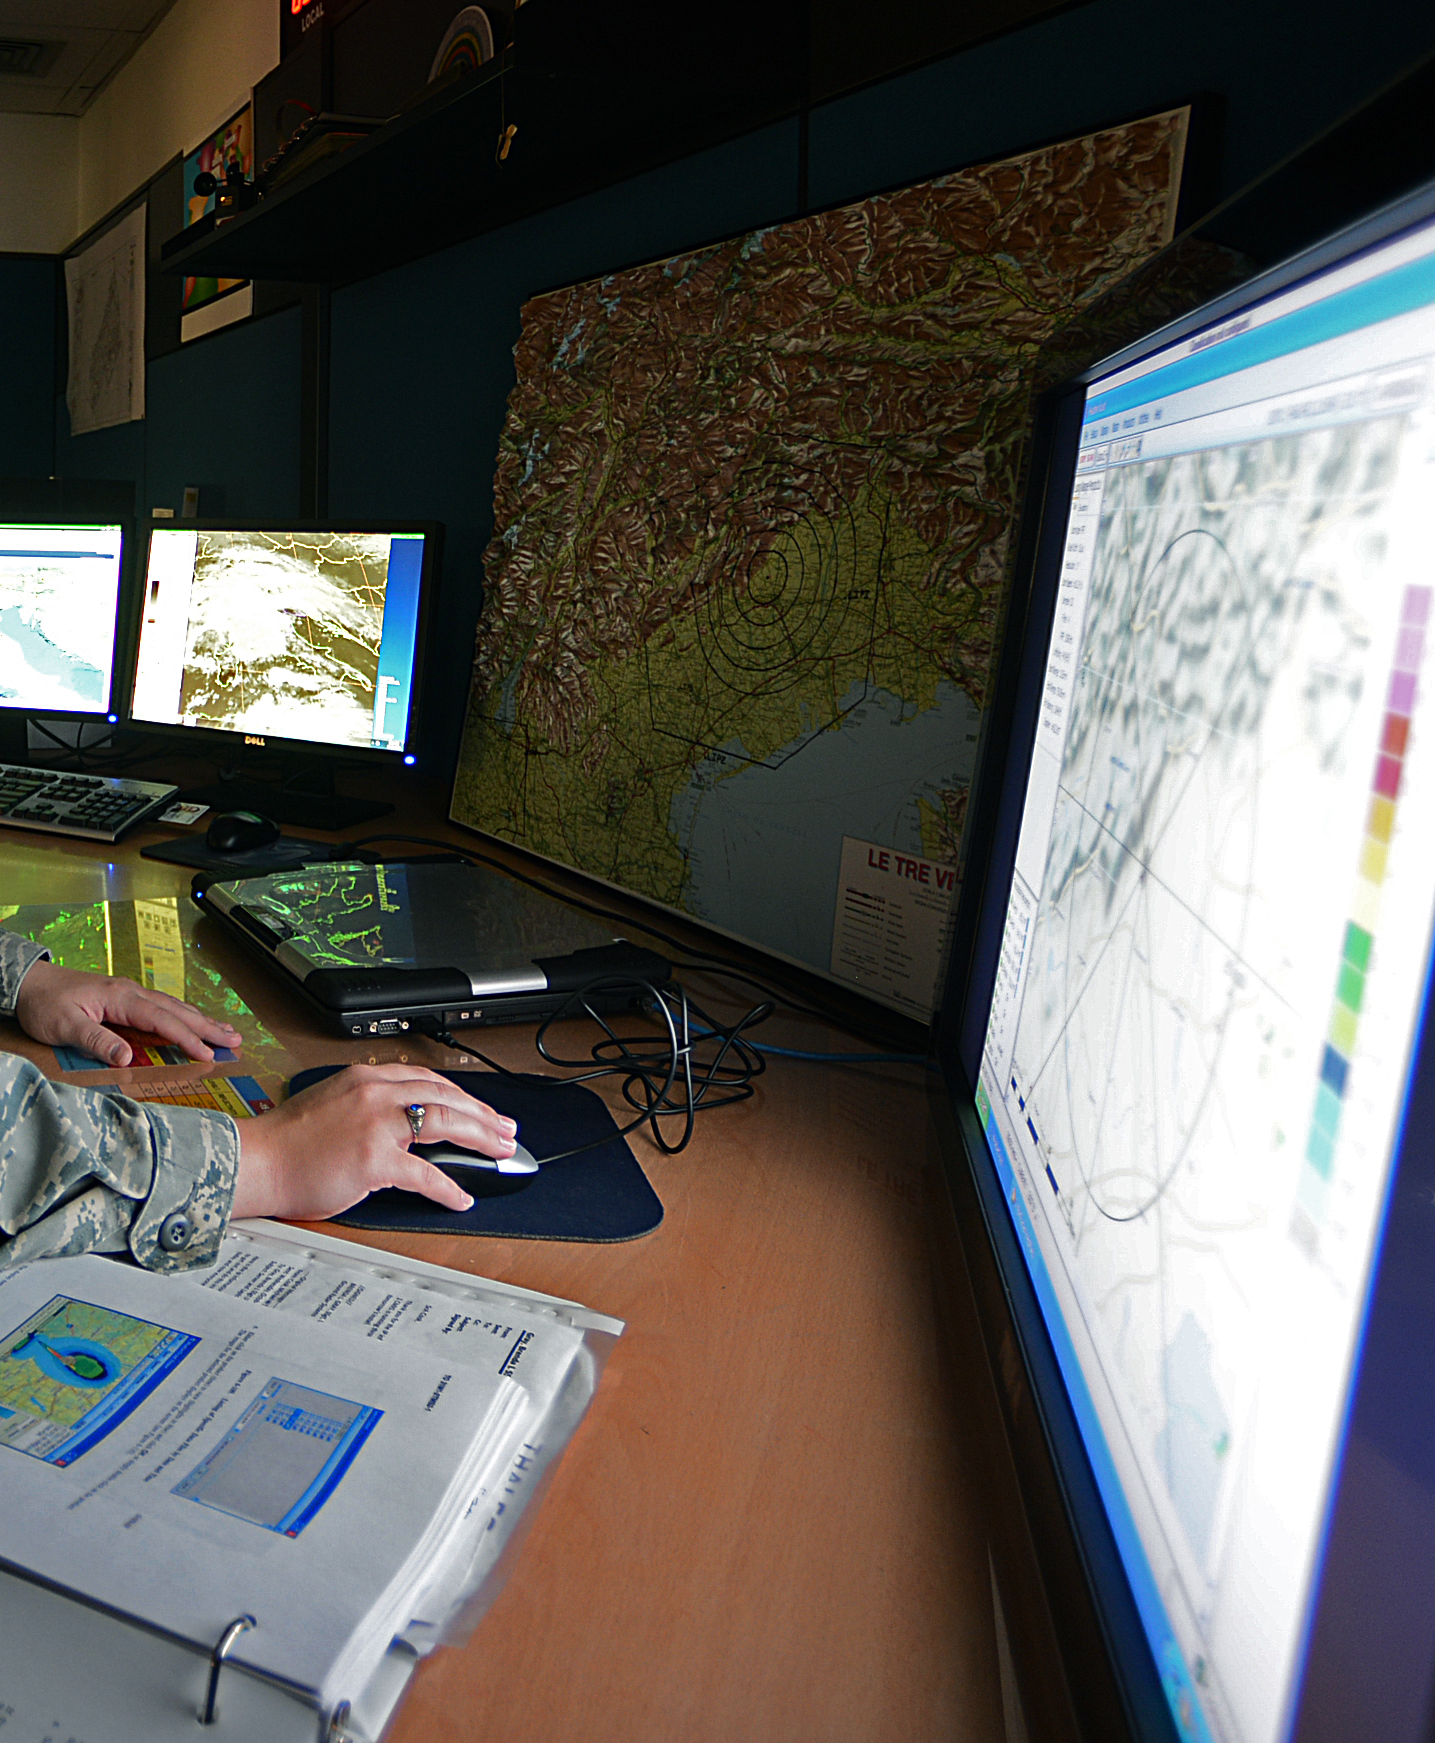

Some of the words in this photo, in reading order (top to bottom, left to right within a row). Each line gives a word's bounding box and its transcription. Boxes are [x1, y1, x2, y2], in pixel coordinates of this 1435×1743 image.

[300, 1, 324, 32] LOCAL
[243, 734, 266, 747] DELL
[868, 848, 891, 872] LE
[895, 855, 931, 884] TRE
